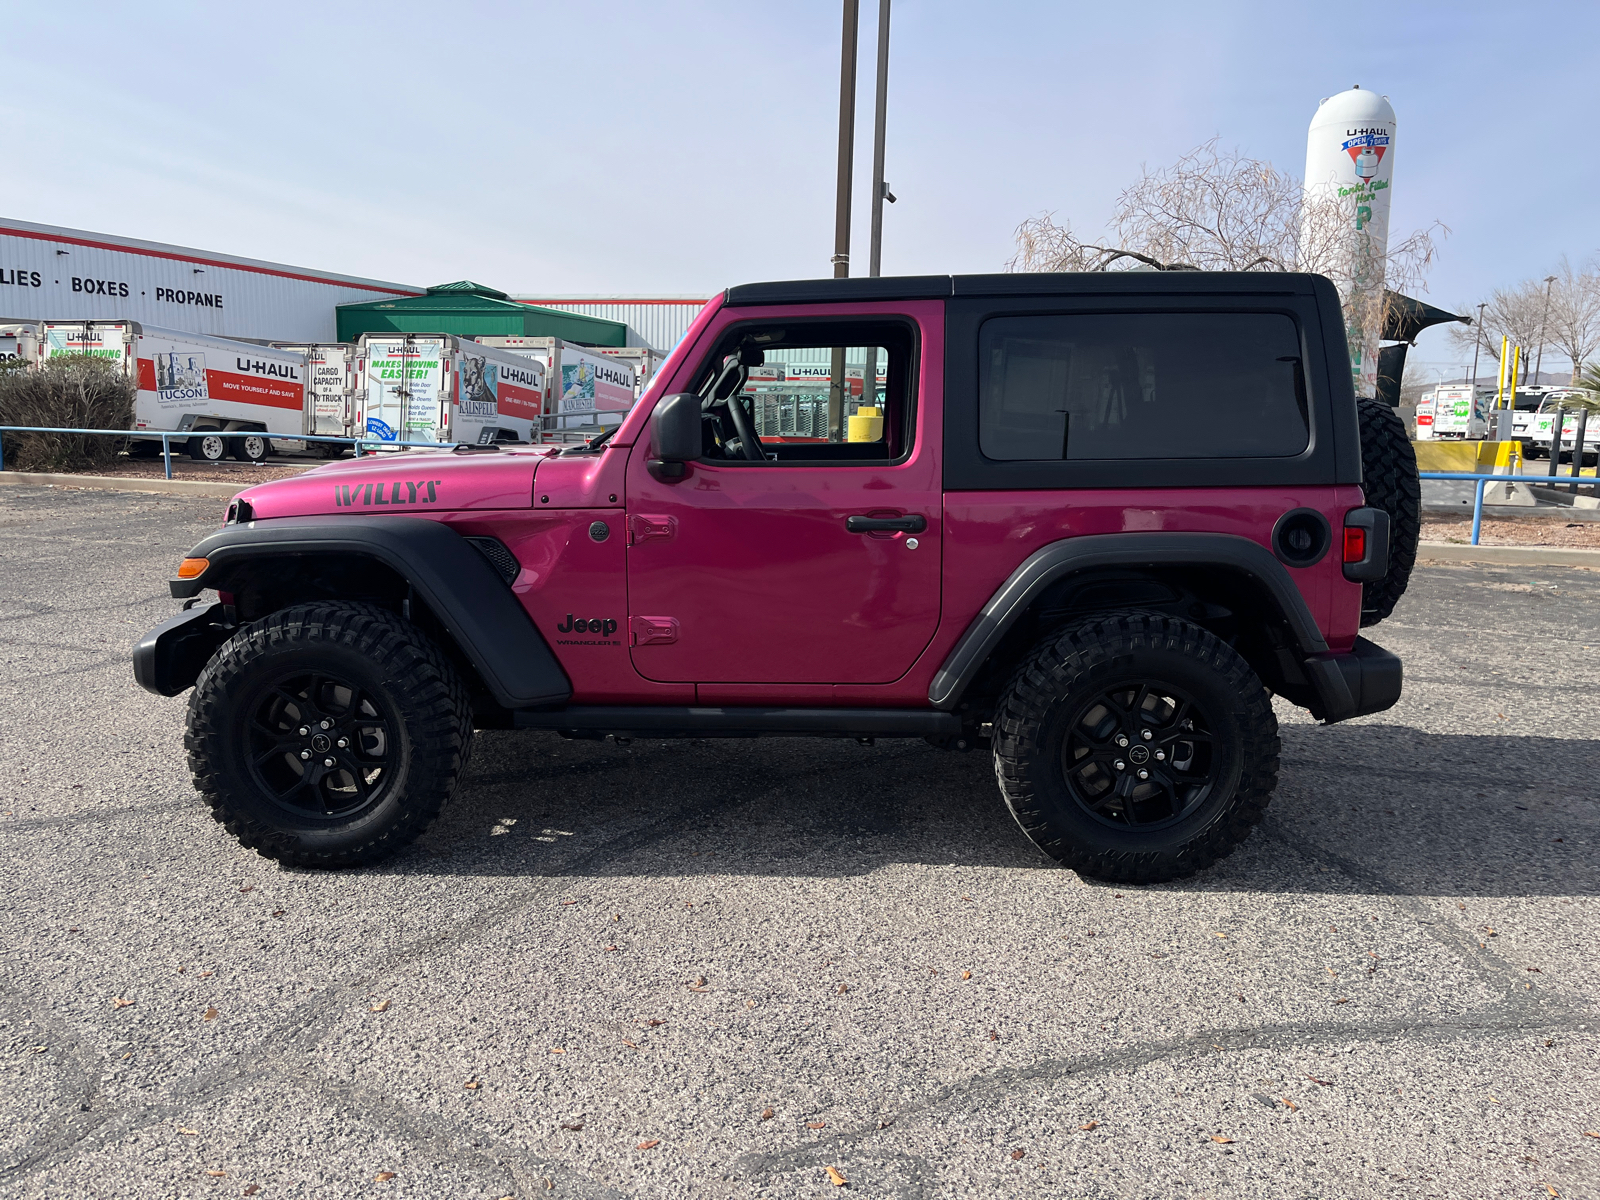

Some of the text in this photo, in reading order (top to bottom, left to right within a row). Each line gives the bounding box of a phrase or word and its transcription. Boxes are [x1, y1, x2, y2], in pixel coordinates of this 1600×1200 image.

[1346, 128, 1388, 136] U-HAUL
[1347, 137, 1367, 147] OPEN
[1337, 178, 1389, 198] Tanks Filled
[1356, 192, 1376, 203] Here
[71, 277, 129, 297] BOXES
[156, 287, 224, 308] PROPANE
[67, 332, 103, 342] U-HAUL
[388, 346, 420, 354] U-HAUL
[236, 357, 299, 380] U-HAUL
[371, 360, 439, 369] MAKES MOVING
[317, 367, 338, 376] CARGO
[380, 369, 429, 380] EASIER!
[501, 366, 539, 387] U-HAUL
[594, 365, 631, 388] U-HAUL
[313, 377, 343, 386] CAPACITY
[158, 388, 203, 400] TUCSON
[222, 382, 240, 391] MOVE
[241, 384, 269, 395] YOURSELF
[281, 390, 295, 398] SAVE
[459, 400, 494, 416] KALISPELL
[334, 480, 442, 507] WILLYS
[557, 613, 617, 637] Jeep
